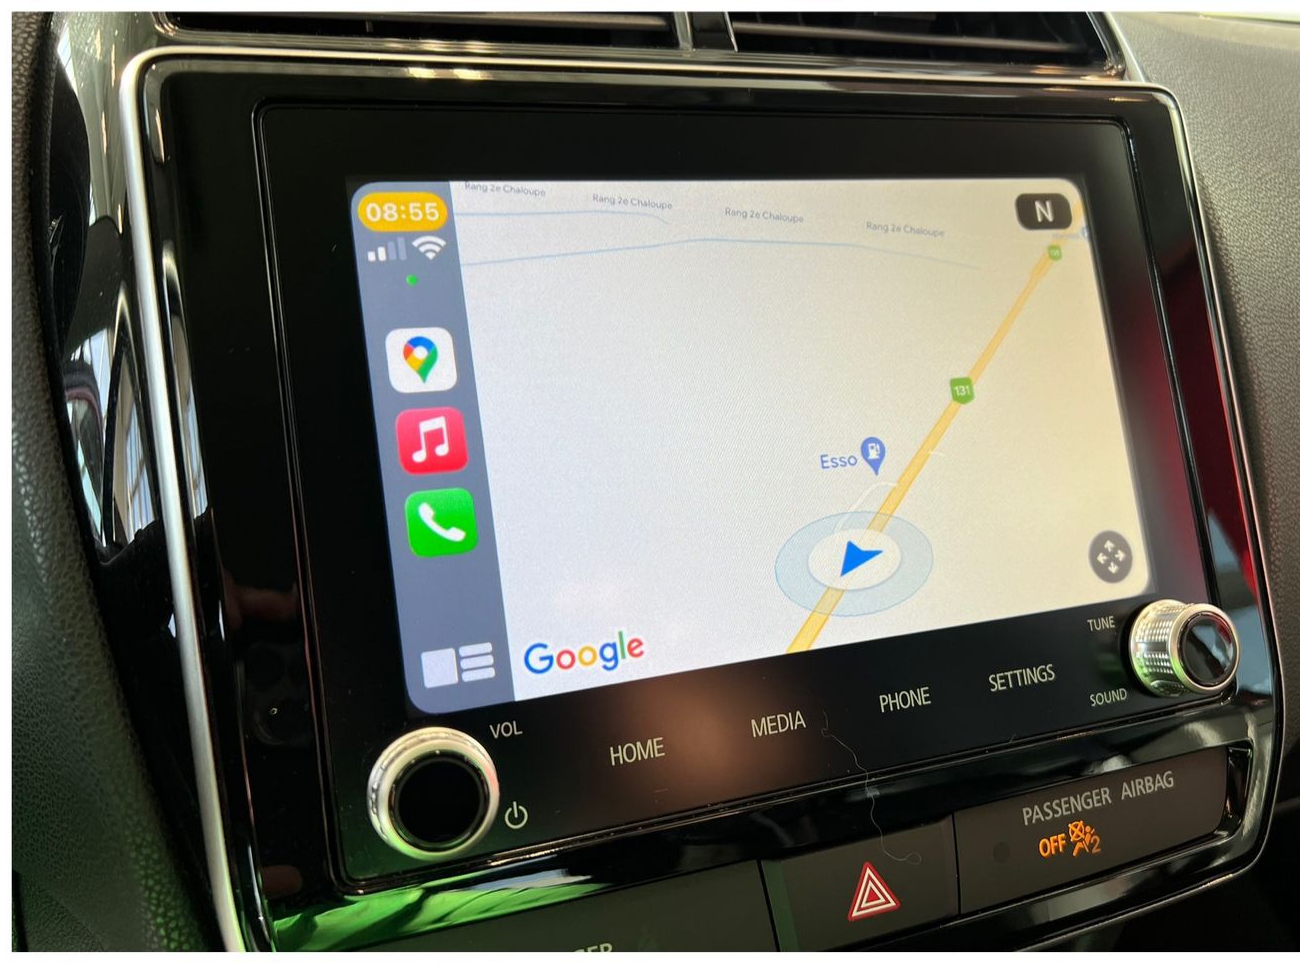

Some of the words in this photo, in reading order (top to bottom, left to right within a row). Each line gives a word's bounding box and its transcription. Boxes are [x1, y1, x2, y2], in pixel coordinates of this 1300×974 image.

[464, 181, 486, 194] Rang
[503, 186, 546, 197] Chaloupe
[365, 202, 440, 224] 08:55
[593, 194, 615, 206] Rang
[631, 198, 673, 210] Chaloupe
[1034, 200, 1054, 223] N
[725, 207, 747, 219] Rang
[762, 211, 804, 223] Chaloupe
[866, 221, 888, 234] Rang
[903, 225, 945, 238] Chaloupe
[820, 452, 857, 471] Esso
[1087, 615, 1115, 631] TUNE
[524, 631, 644, 674] Google
[988, 664, 1055, 691] SETTINGS
[879, 686, 931, 713] PHONE
[1089, 687, 1127, 706] SOUND
[489, 720, 523, 739] VOL
[751, 710, 806, 739] MEDIA
[609, 737, 665, 767] HOME
[1022, 787, 1112, 826] PASSENGER
[1121, 770, 1175, 800] AIRBAG
[1038, 833, 1066, 858] OFF
